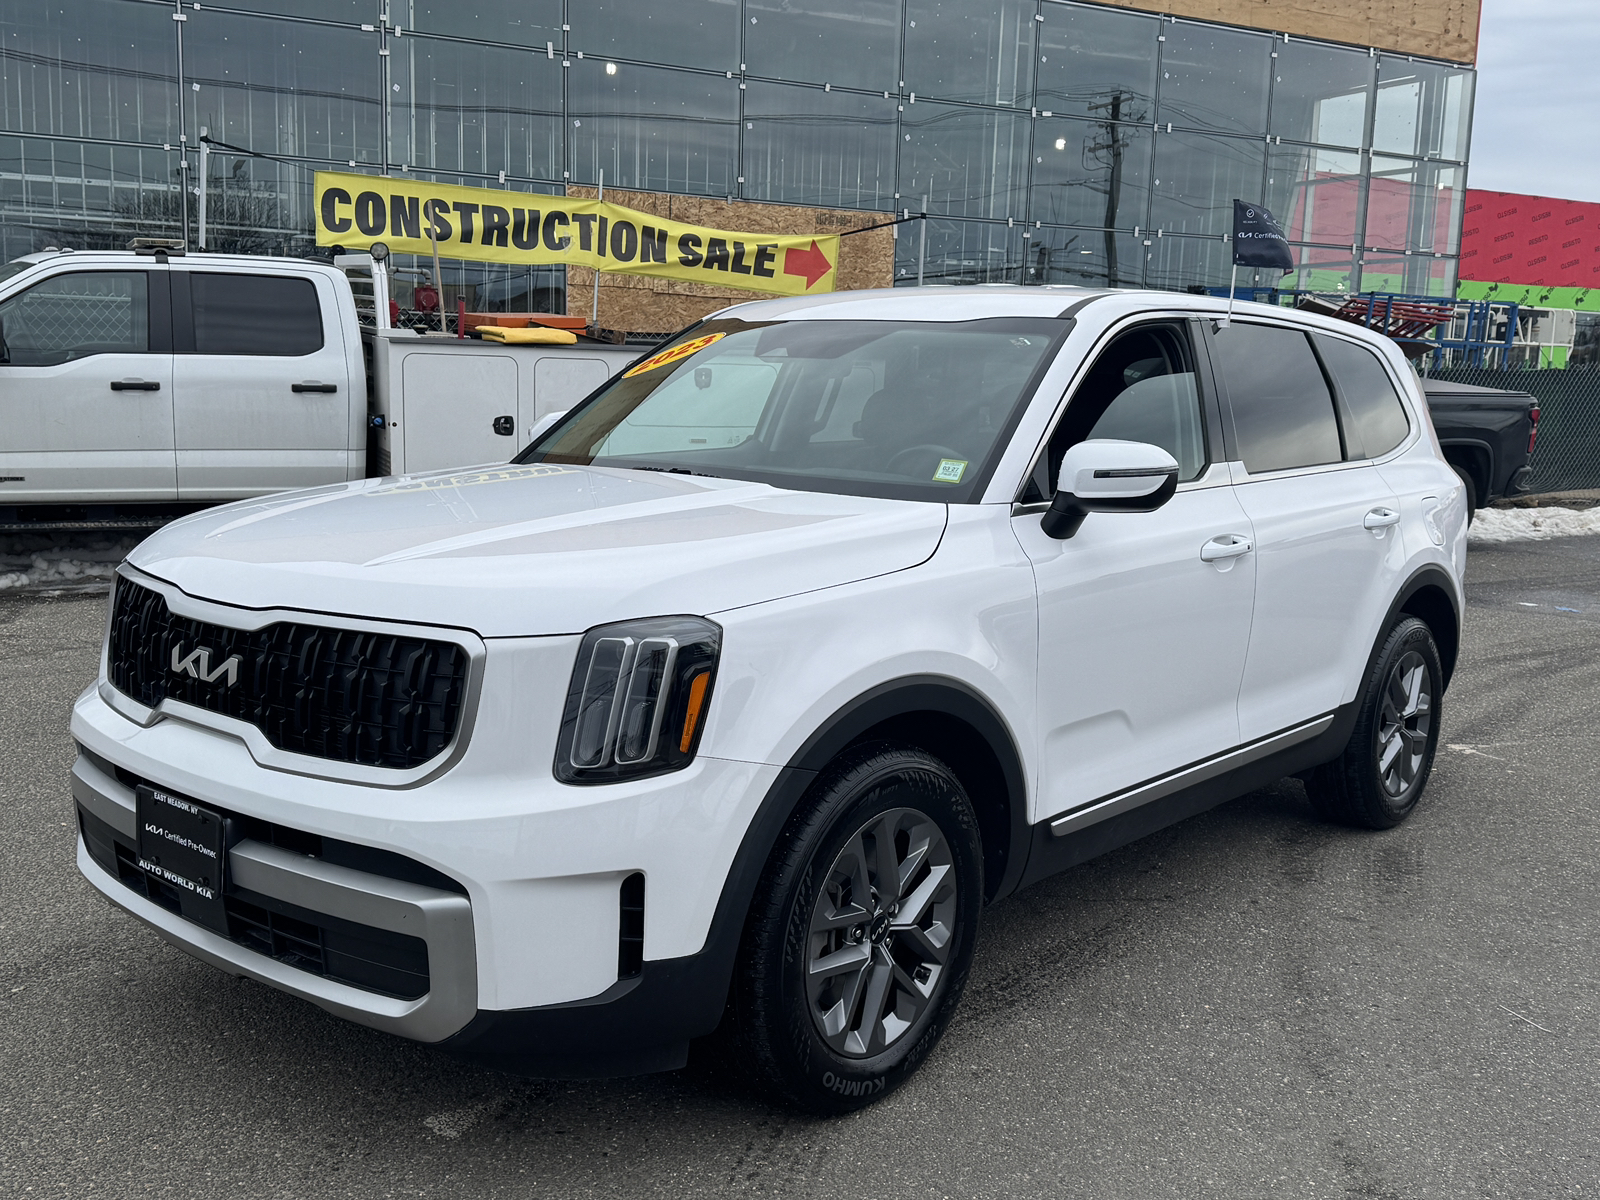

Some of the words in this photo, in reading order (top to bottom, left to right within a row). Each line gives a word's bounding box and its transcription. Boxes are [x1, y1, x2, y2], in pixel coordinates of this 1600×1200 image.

[321, 186, 668, 264] CONSTRUCTION
[678, 232, 778, 278] SALE
[1462, 227, 1480, 238] ESISTO
[1494, 231, 1515, 243] RESISTO
[1528, 234, 1549, 246] RESISTO
[630, 335, 717, 375] 2023
[171, 641, 241, 688] KIA
[153, 792, 167, 803] EAST
[190, 806, 199, 815] NY
[145, 823, 163, 836] KIA
[164, 830, 187, 847] Certified
[139, 860, 162, 875] AUTO
[163, 870, 194, 891] WORLD
[196, 886, 213, 899] KIA
[822, 1071, 886, 1097] KUMHO
